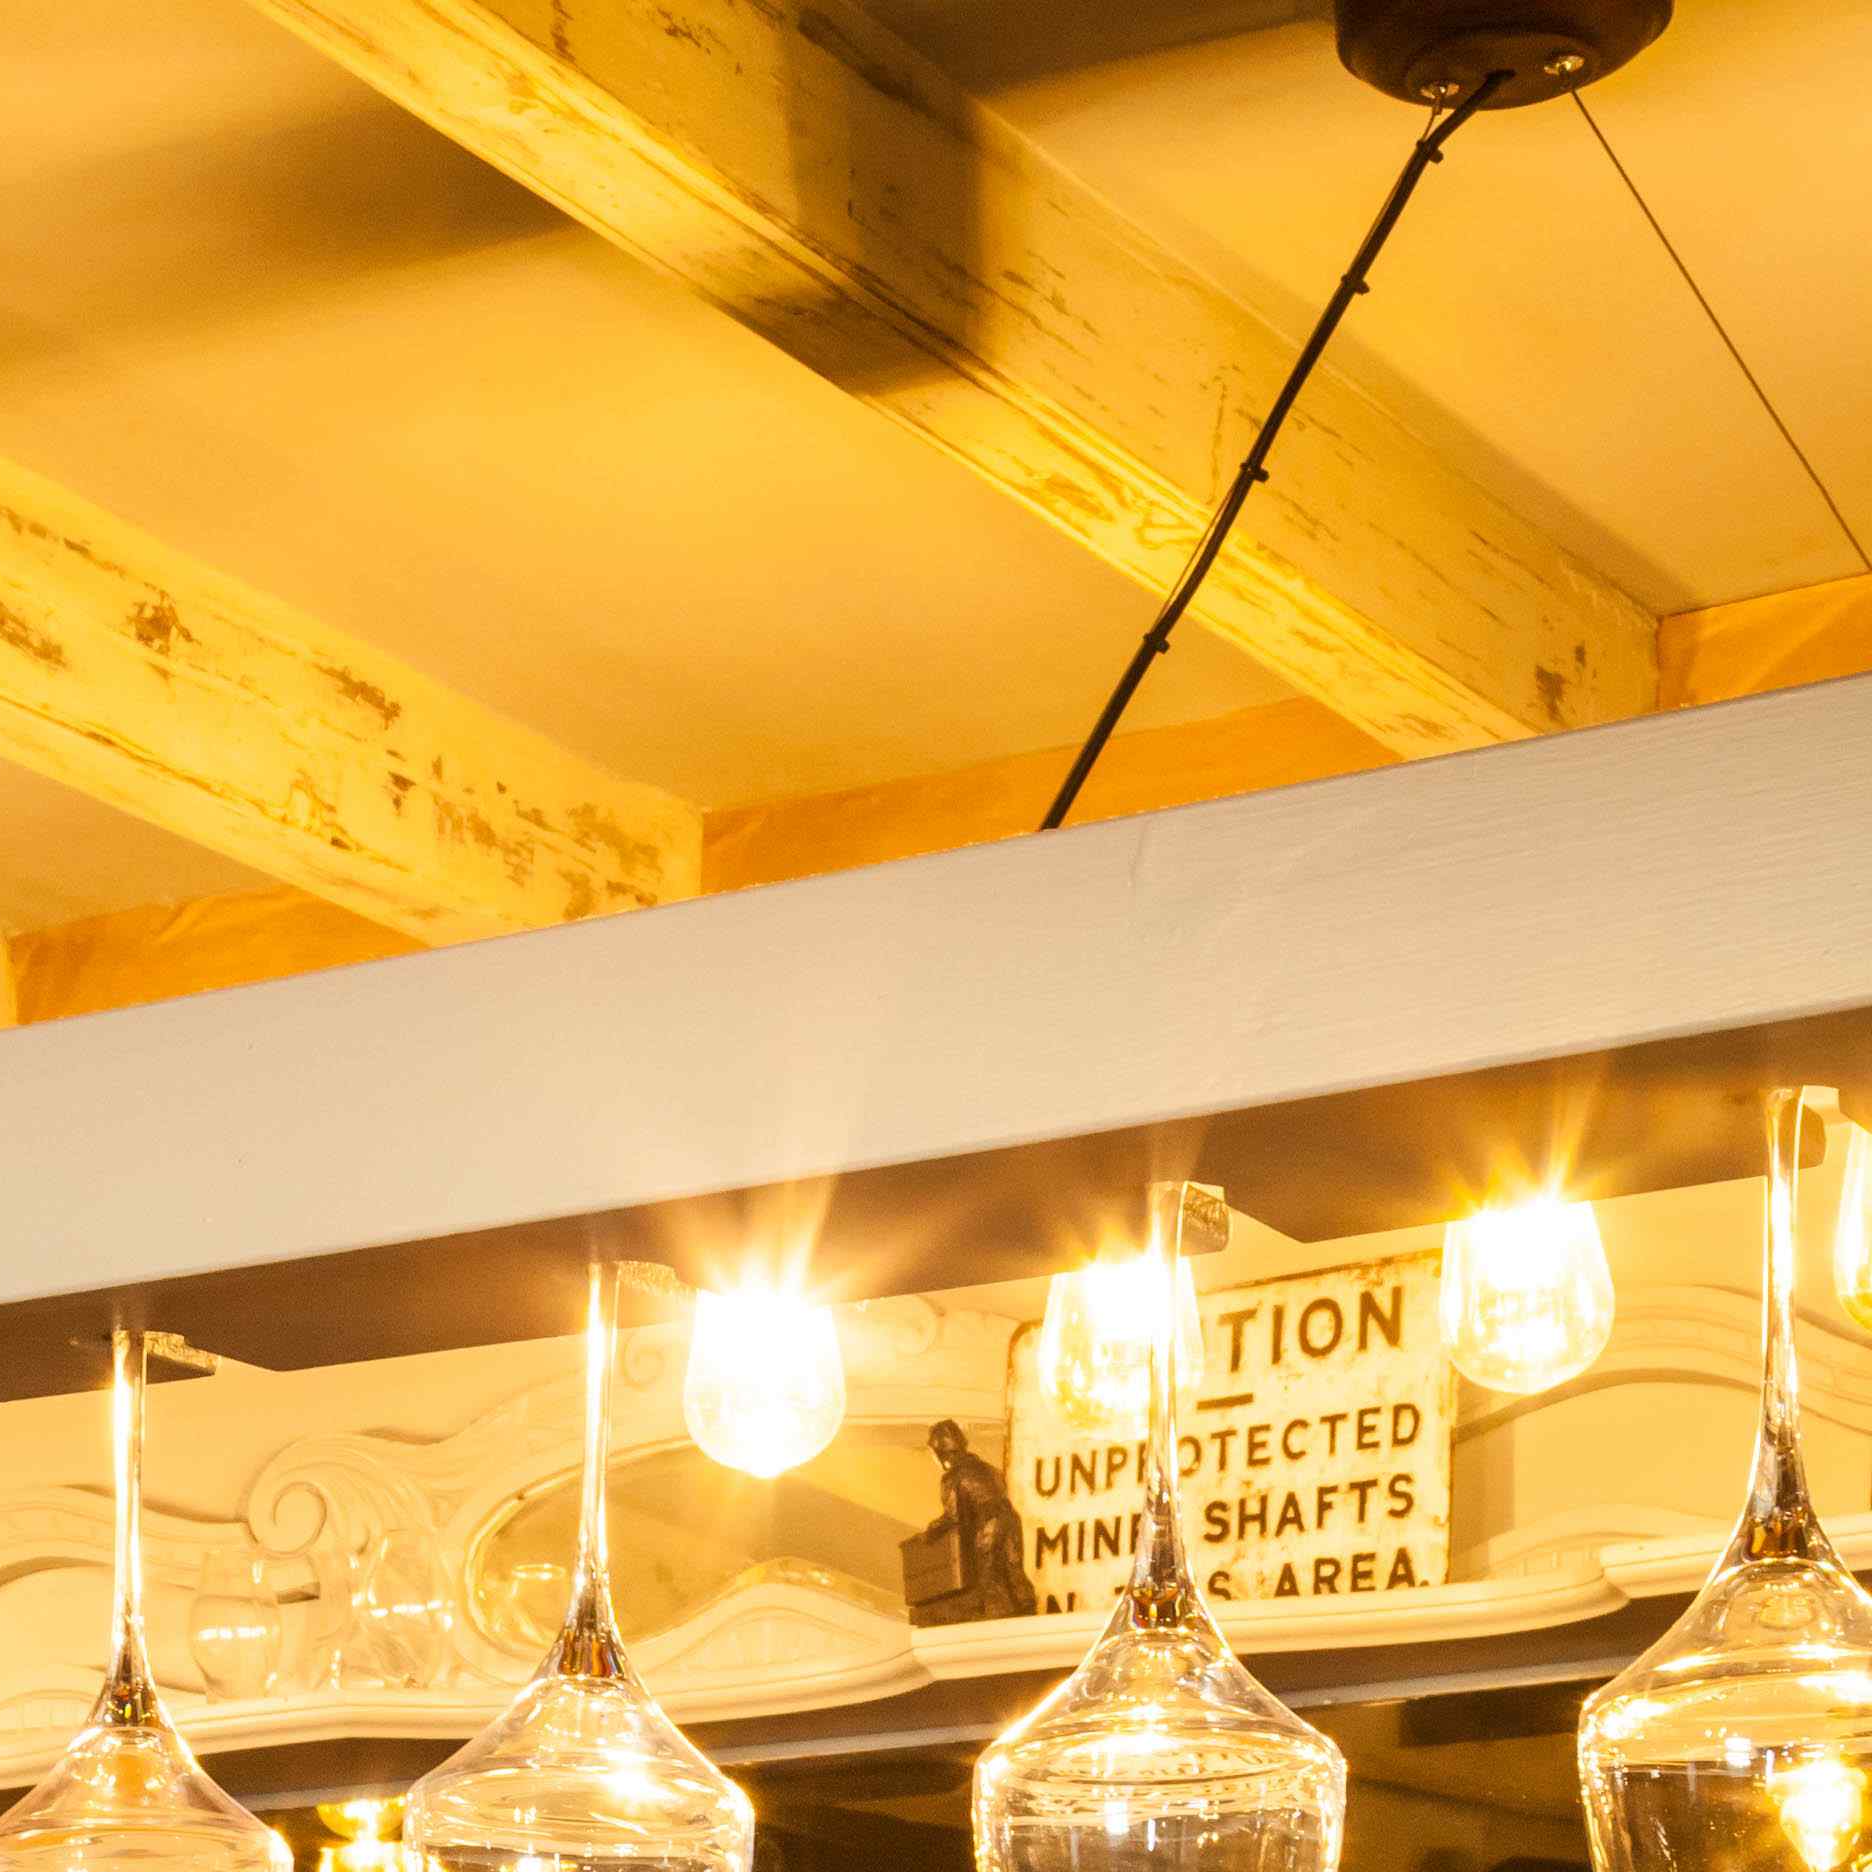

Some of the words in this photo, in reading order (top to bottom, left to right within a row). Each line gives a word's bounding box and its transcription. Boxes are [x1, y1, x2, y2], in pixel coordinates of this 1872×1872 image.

[1217, 1285, 1403, 1373] TION
[1203, 1473, 1416, 1544] SHAFTS
[1273, 1546, 1430, 1599] AREA.
